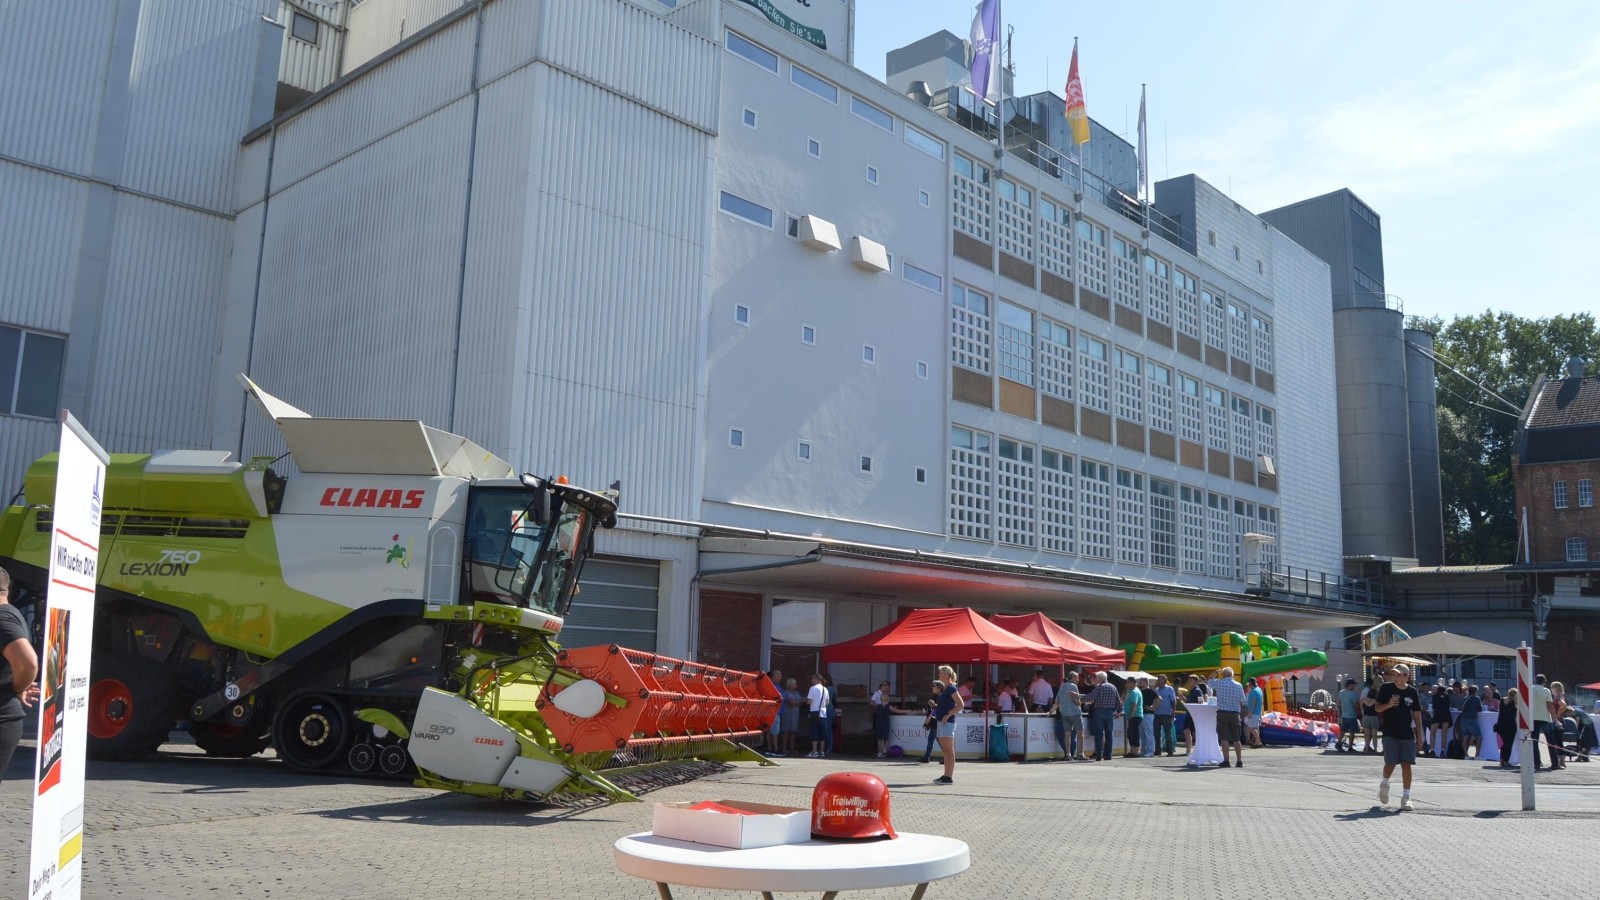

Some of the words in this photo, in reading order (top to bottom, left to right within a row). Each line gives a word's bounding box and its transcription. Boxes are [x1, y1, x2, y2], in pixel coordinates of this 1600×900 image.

[319, 487, 426, 509] CLAAS
[57, 544, 68, 568] WIR
[67, 553, 83, 574] suchen
[157, 548, 202, 564] 760
[119, 562, 190, 577] LEXION
[227, 687, 238, 698] 30
[414, 731, 440, 741] VARIO
[429, 724, 456, 735] 930
[474, 736, 505, 747] CLAAS
[832, 794, 869, 808] Freiwillige
